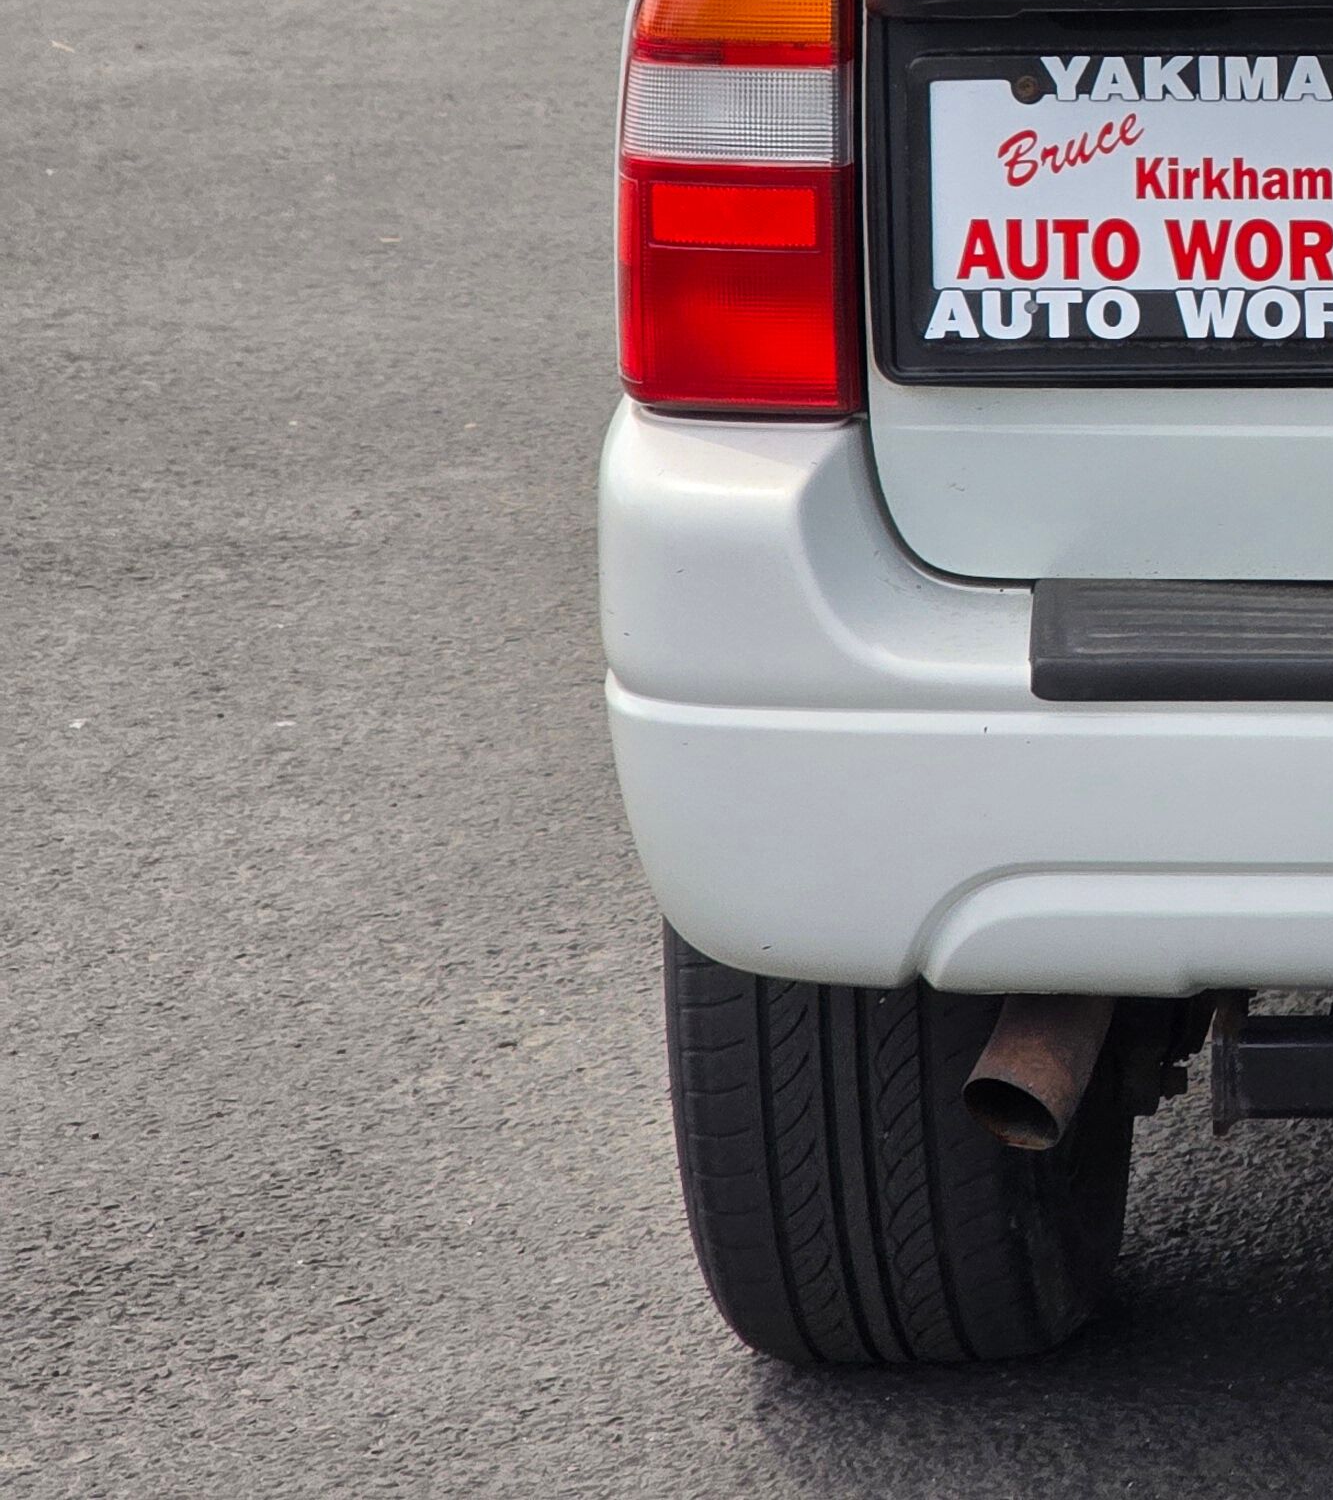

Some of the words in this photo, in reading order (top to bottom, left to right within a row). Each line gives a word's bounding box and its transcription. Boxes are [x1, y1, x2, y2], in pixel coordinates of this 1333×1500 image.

[997, 112, 1144, 188] Bruce
[955, 218, 1141, 282] AUTO
[923, 287, 1141, 341] AUTO
